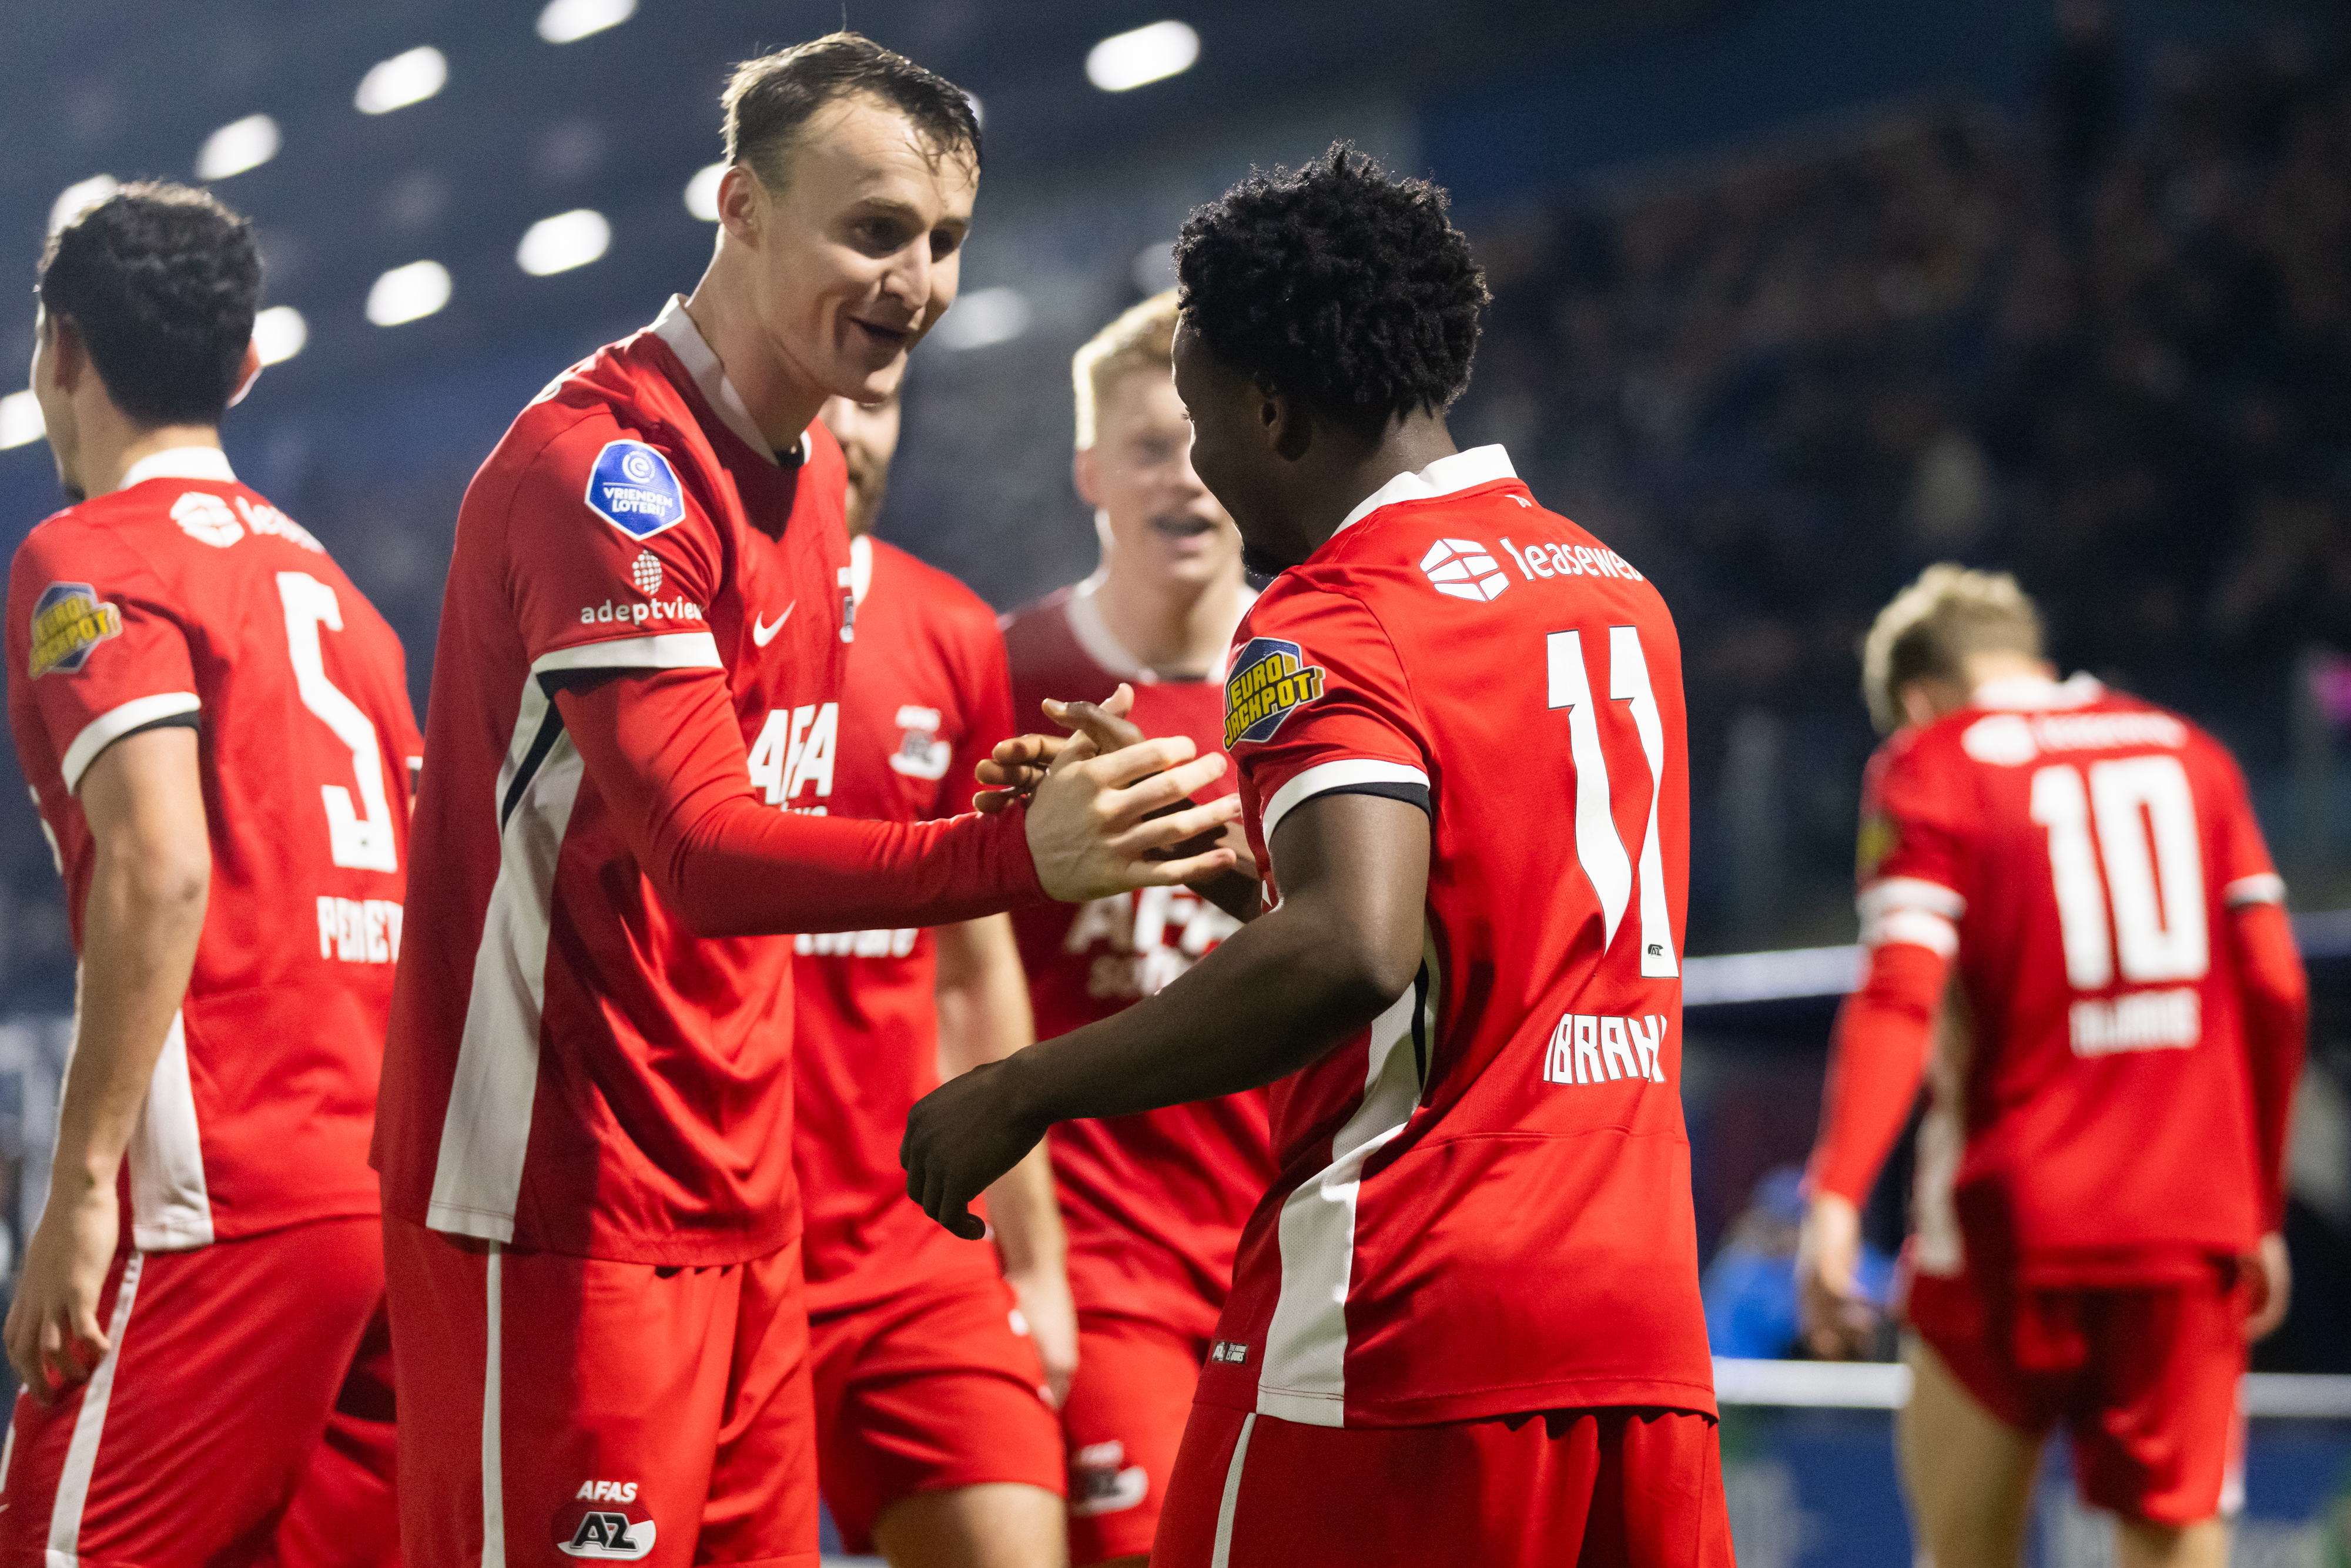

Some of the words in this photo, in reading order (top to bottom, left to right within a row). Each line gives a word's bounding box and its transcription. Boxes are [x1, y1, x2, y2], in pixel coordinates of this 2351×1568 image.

[603, 487, 673, 507] VRIENDEN
[612, 499, 665, 517] LOTERIJ
[1225, 672, 1311, 746] JACKPOT
[1230, 655, 1283, 709] EURO
[276, 571, 398, 873] 5
[1546, 626, 1679, 978] 11
[2029, 754, 2210, 991] 10
[575, 1480, 638, 1503] AFAS
[570, 1511, 639, 1552] AZ
